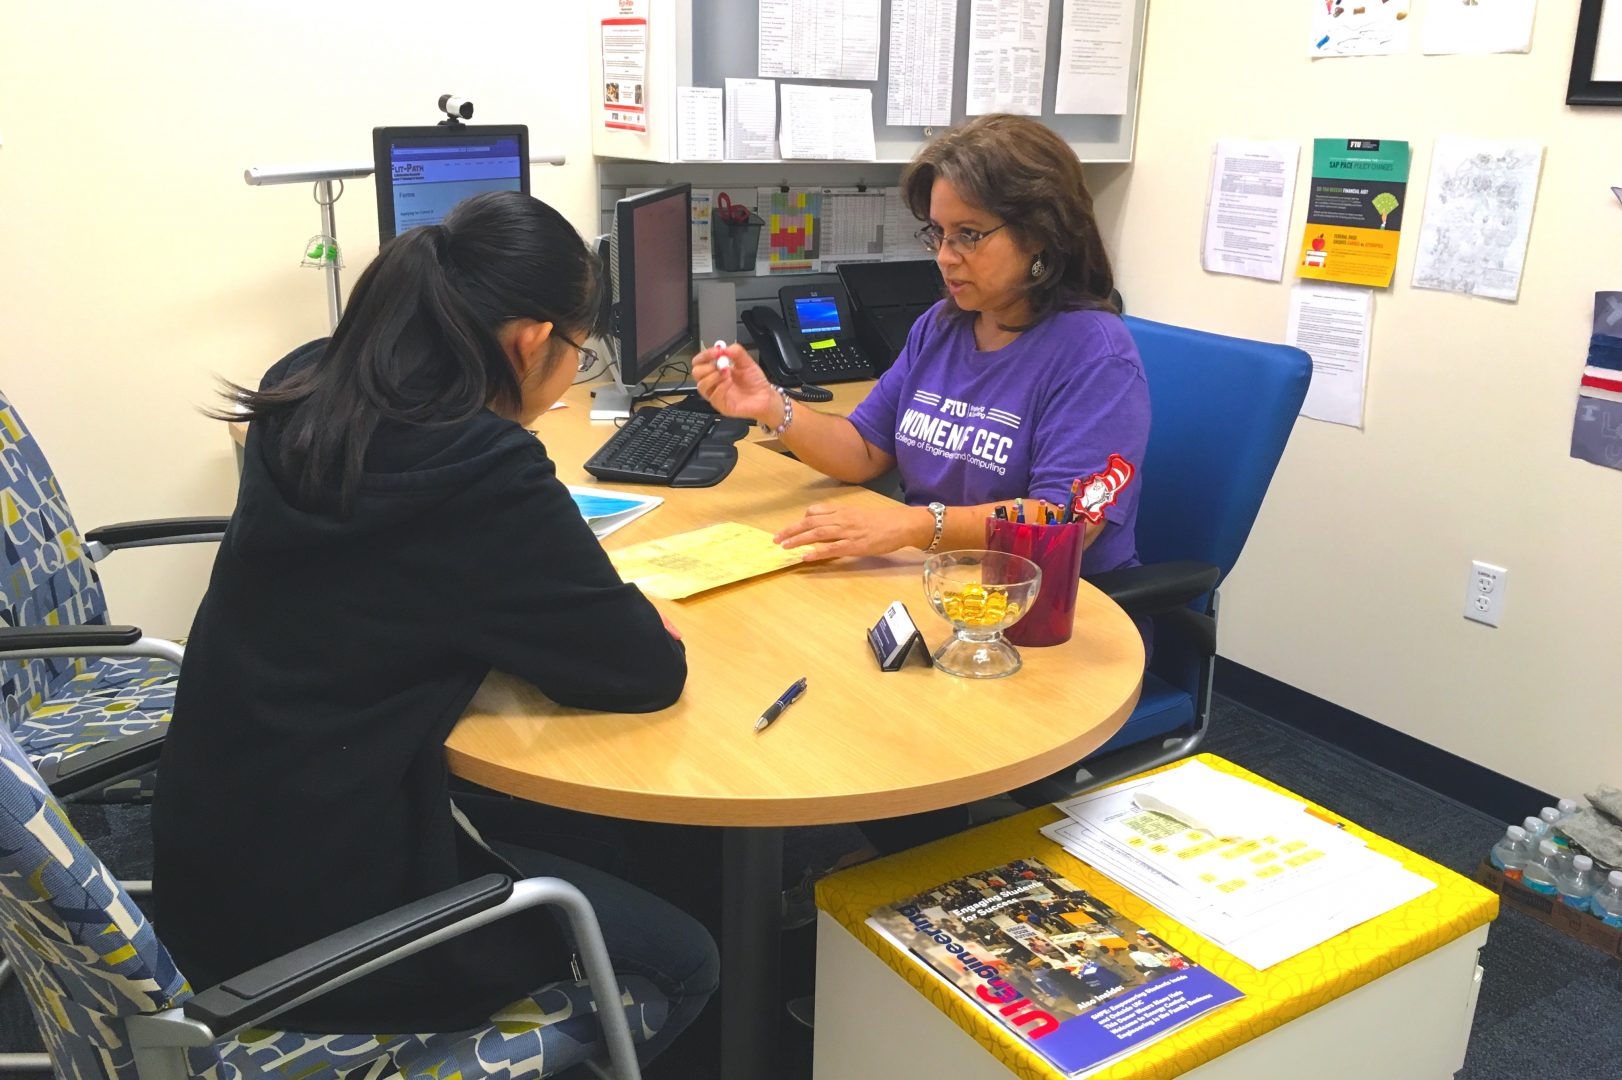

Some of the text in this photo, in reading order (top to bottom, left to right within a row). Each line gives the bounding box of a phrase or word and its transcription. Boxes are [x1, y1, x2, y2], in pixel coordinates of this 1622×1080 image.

[1371, 162, 1393, 171] CHANGES
[940, 398, 968, 418] FIU
[899, 408, 964, 451] WOMEN
[972, 428, 1013, 464] CEC
[895, 432, 916, 446] College
[917, 441, 925, 449] of
[966, 454, 1006, 476] Computing
[952, 882, 1044, 916] Engaging Students
[962, 898, 1019, 923] for Success
[897, 904, 1024, 1003] Engineering
[1077, 986, 1124, 1010] Also Inside:
[1109, 992, 1147, 1011] Empowering
[1144, 982, 1172, 993] Students
[1169, 975, 1188, 983] Inside
[976, 980, 1060, 1040] UIC
[1098, 1000, 1144, 1024] and Outside UIC
[1103, 1021, 1118, 1030] This
[1117, 1013, 1136, 1023] Donor
[1134, 1004, 1154, 1014] Wears
[1152, 997, 1170, 1005] Many
[1110, 1020, 1138, 1034] Welcome
[1144, 1006, 1166, 1018] Energy
[1117, 1020, 1155, 1039] Engineering
[1168, 1004, 1189, 1014] Family
[1186, 994, 1213, 1006] Business
